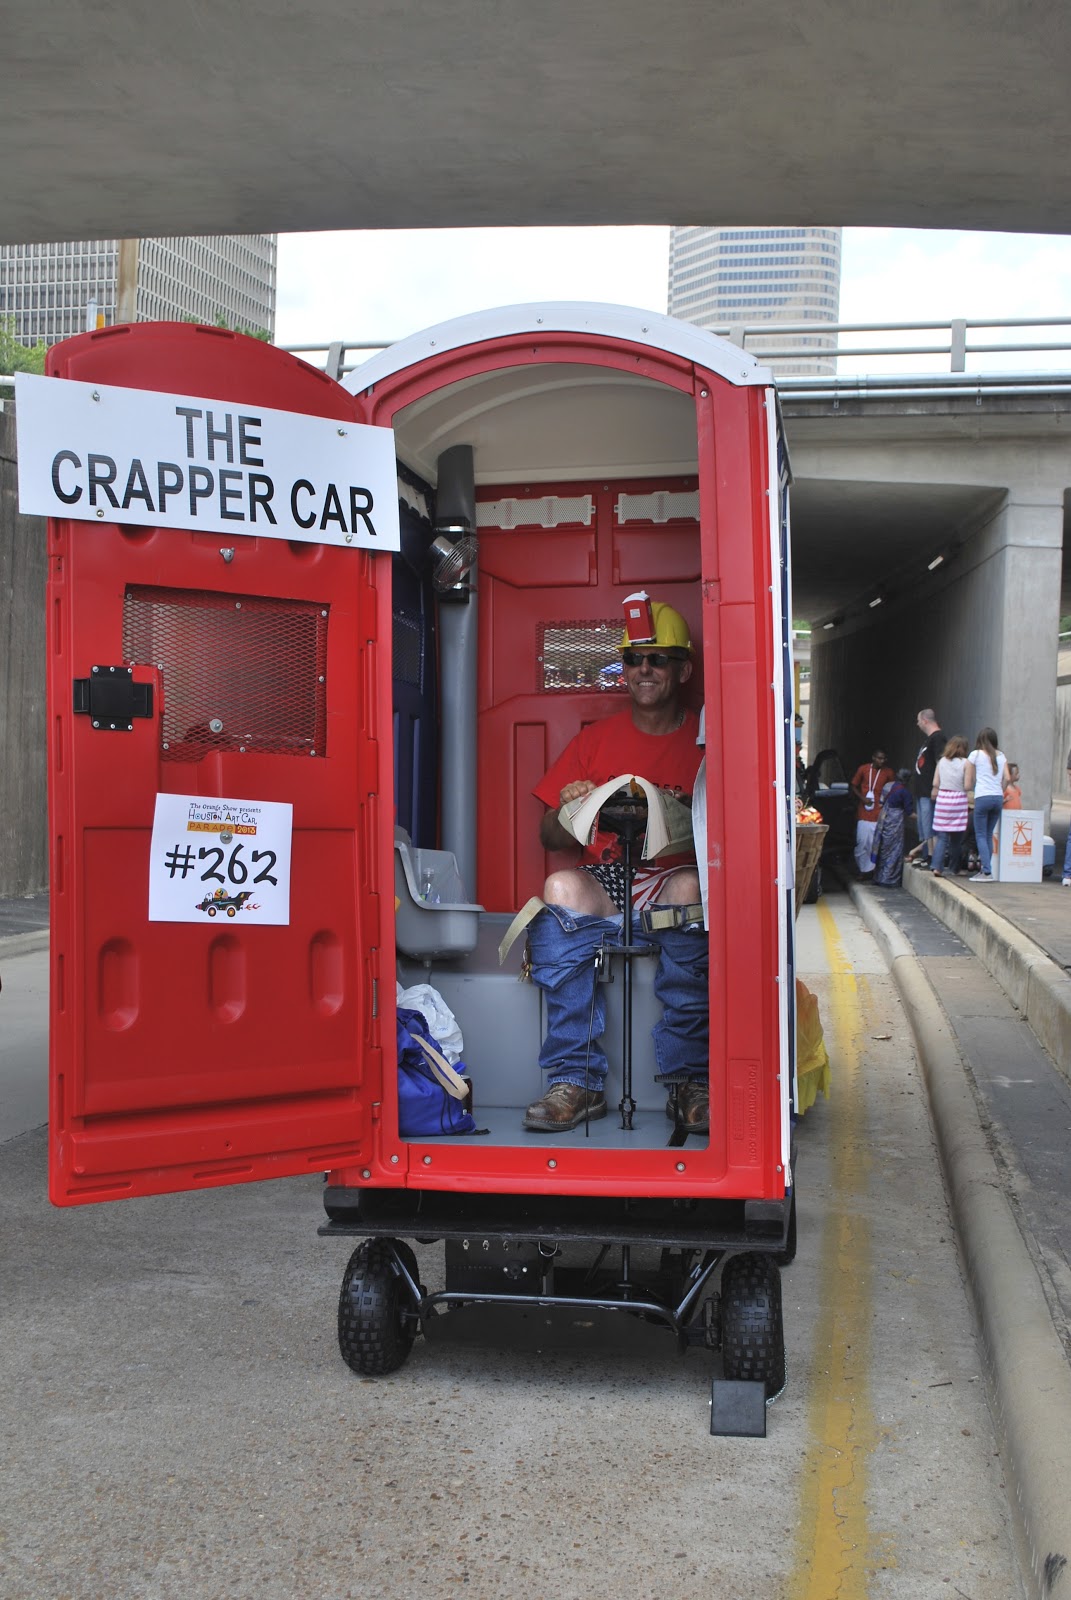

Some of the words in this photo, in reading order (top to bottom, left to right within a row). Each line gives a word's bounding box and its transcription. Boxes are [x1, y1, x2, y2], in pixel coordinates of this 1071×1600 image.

[175, 406, 264, 468] THE
[51, 449, 278, 525] CRAPPER
[290, 478, 377, 536] CAR
[188, 809, 223, 821] HOUSTON
[164, 843, 278, 887] #262
